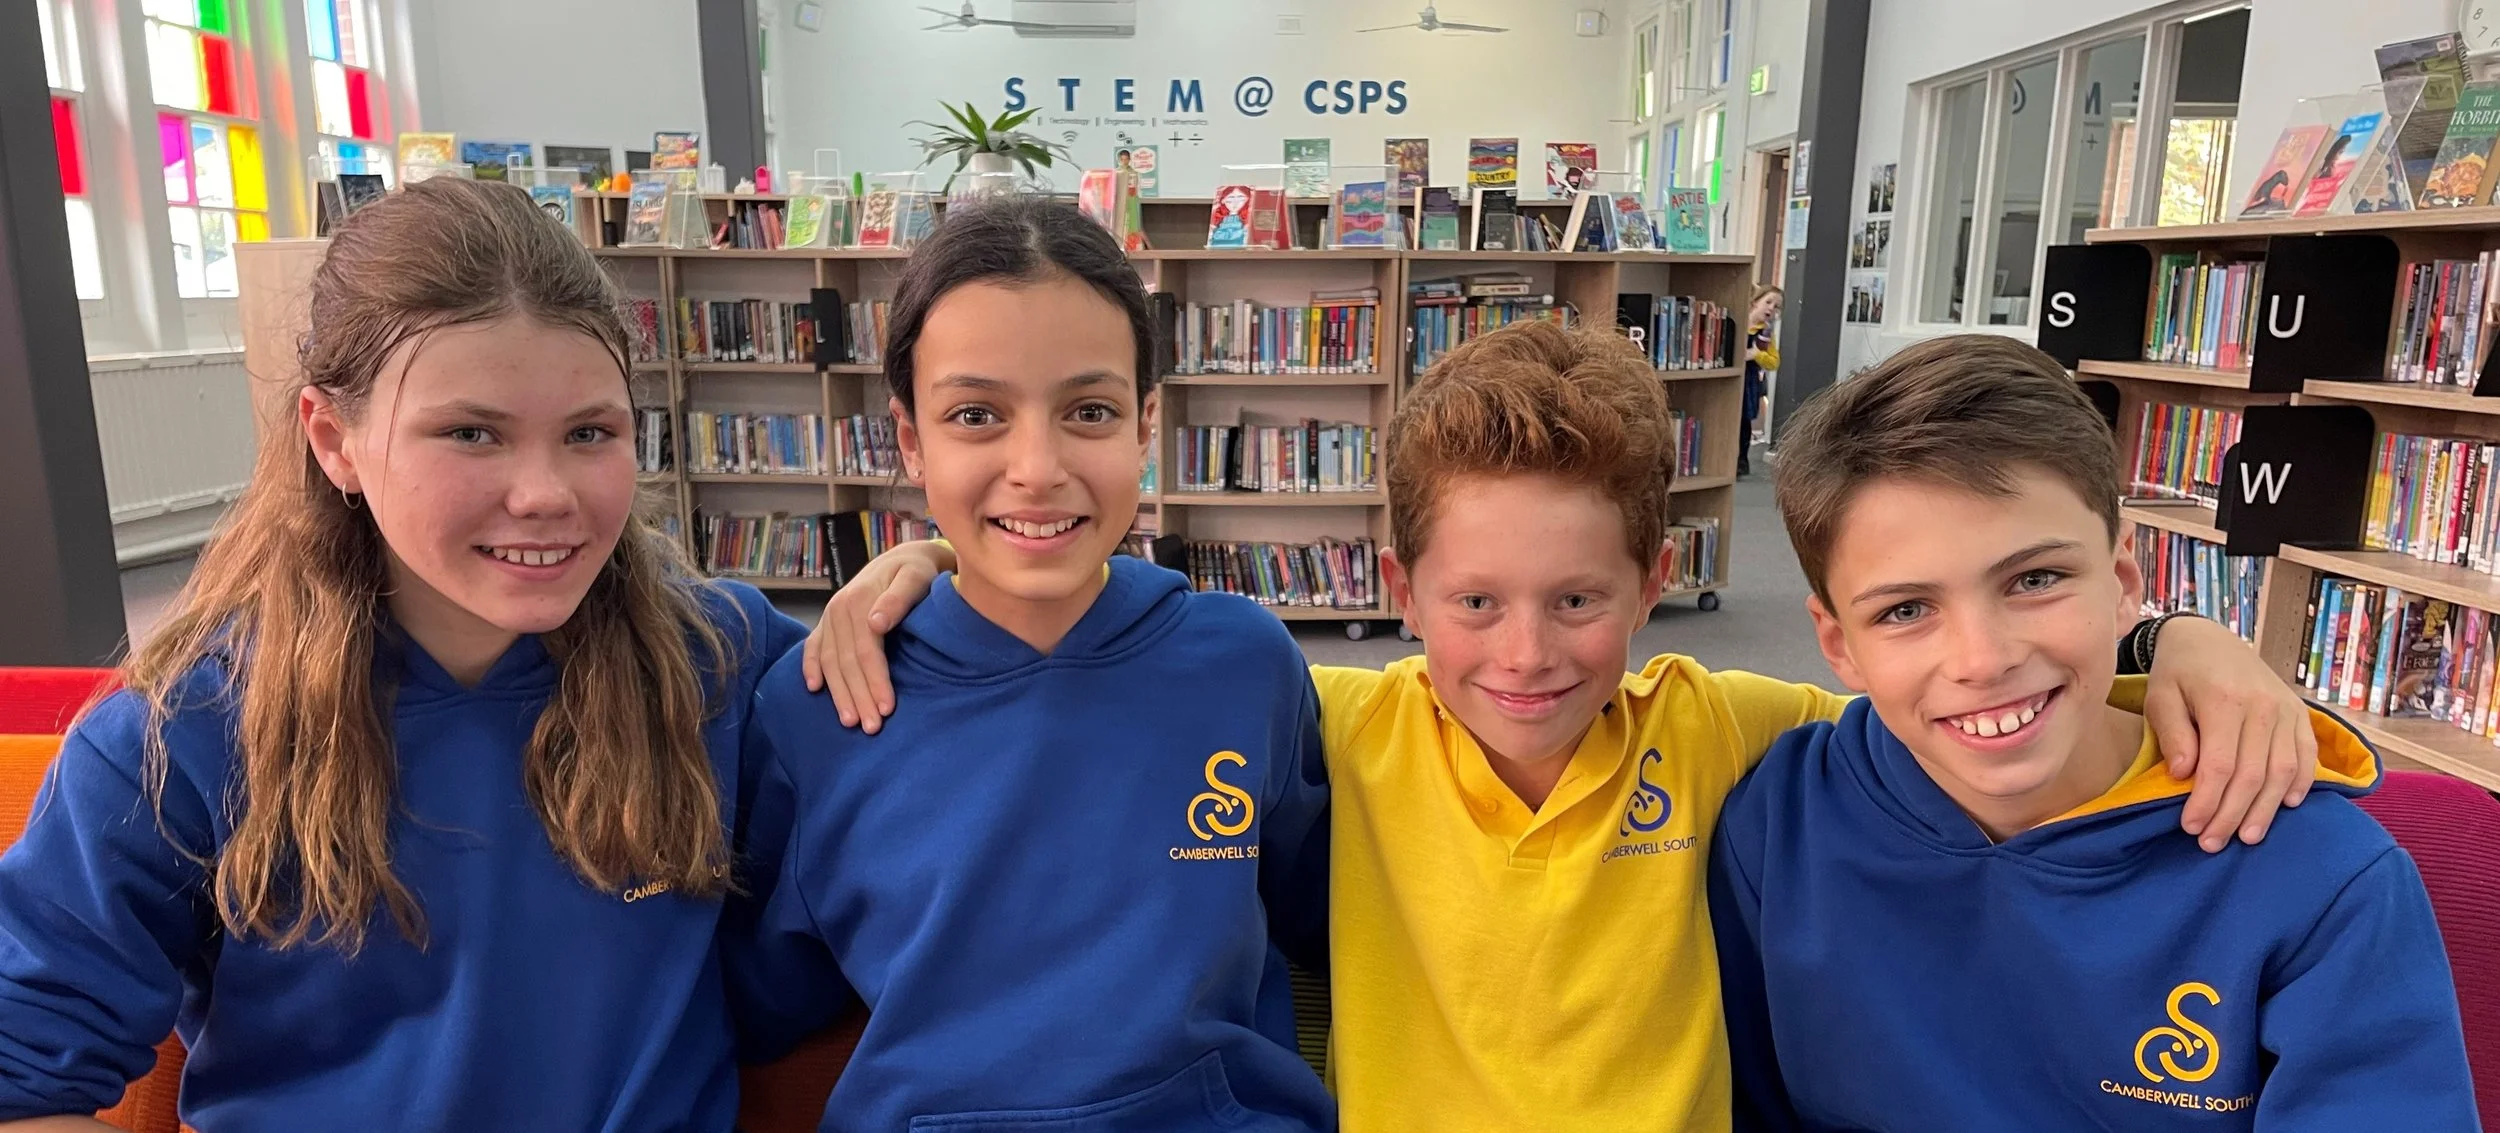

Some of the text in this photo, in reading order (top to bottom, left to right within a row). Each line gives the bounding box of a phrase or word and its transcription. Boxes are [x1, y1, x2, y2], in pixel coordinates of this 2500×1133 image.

[2472, 8, 2484, 20] 8
[2477, 26, 2488, 39] 7
[1235, 76, 1273, 117] @
[1305, 80, 1407, 114] CSPS
[2473, 95, 2493, 107] THE
[1671, 192, 1705, 210] ARTIE
[2047, 292, 2076, 328] S
[2268, 295, 2305, 338] U
[1629, 326, 1646, 351] R
[2240, 463, 2292, 504] W
[1169, 846, 1244, 860] CAMBERWELL
[623, 880, 674, 902] CAMBER
[2100, 1079, 2254, 1113] CAMBERWELL SOUTH
